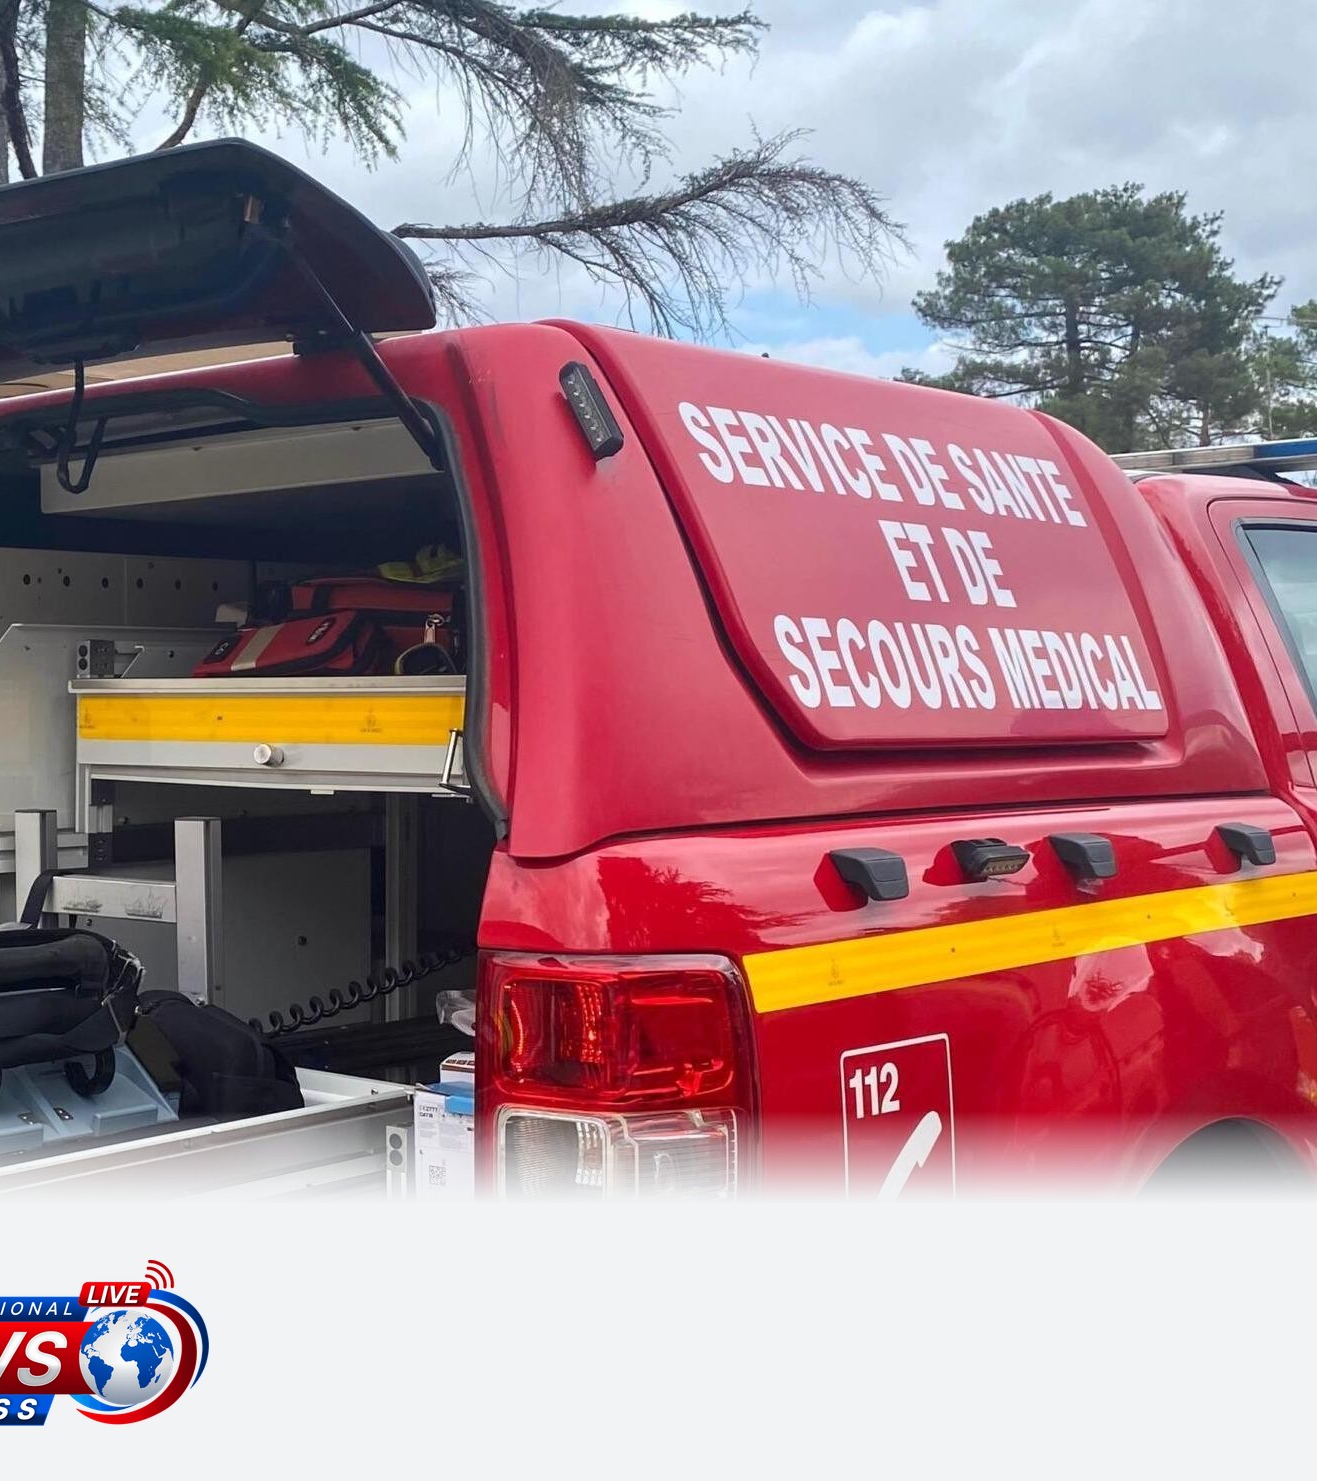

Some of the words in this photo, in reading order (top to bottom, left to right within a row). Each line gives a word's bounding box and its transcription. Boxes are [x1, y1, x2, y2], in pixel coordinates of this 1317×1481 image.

[678, 401, 904, 502] SERVICE
[883, 432, 964, 510] DE
[947, 442, 1087, 527] SANTE
[878, 519, 950, 604] ET
[941, 526, 1017, 608] DE
[773, 614, 996, 710] SECOURS
[987, 626, 1163, 711] MEDICAL
[849, 1062, 900, 1119] 112
